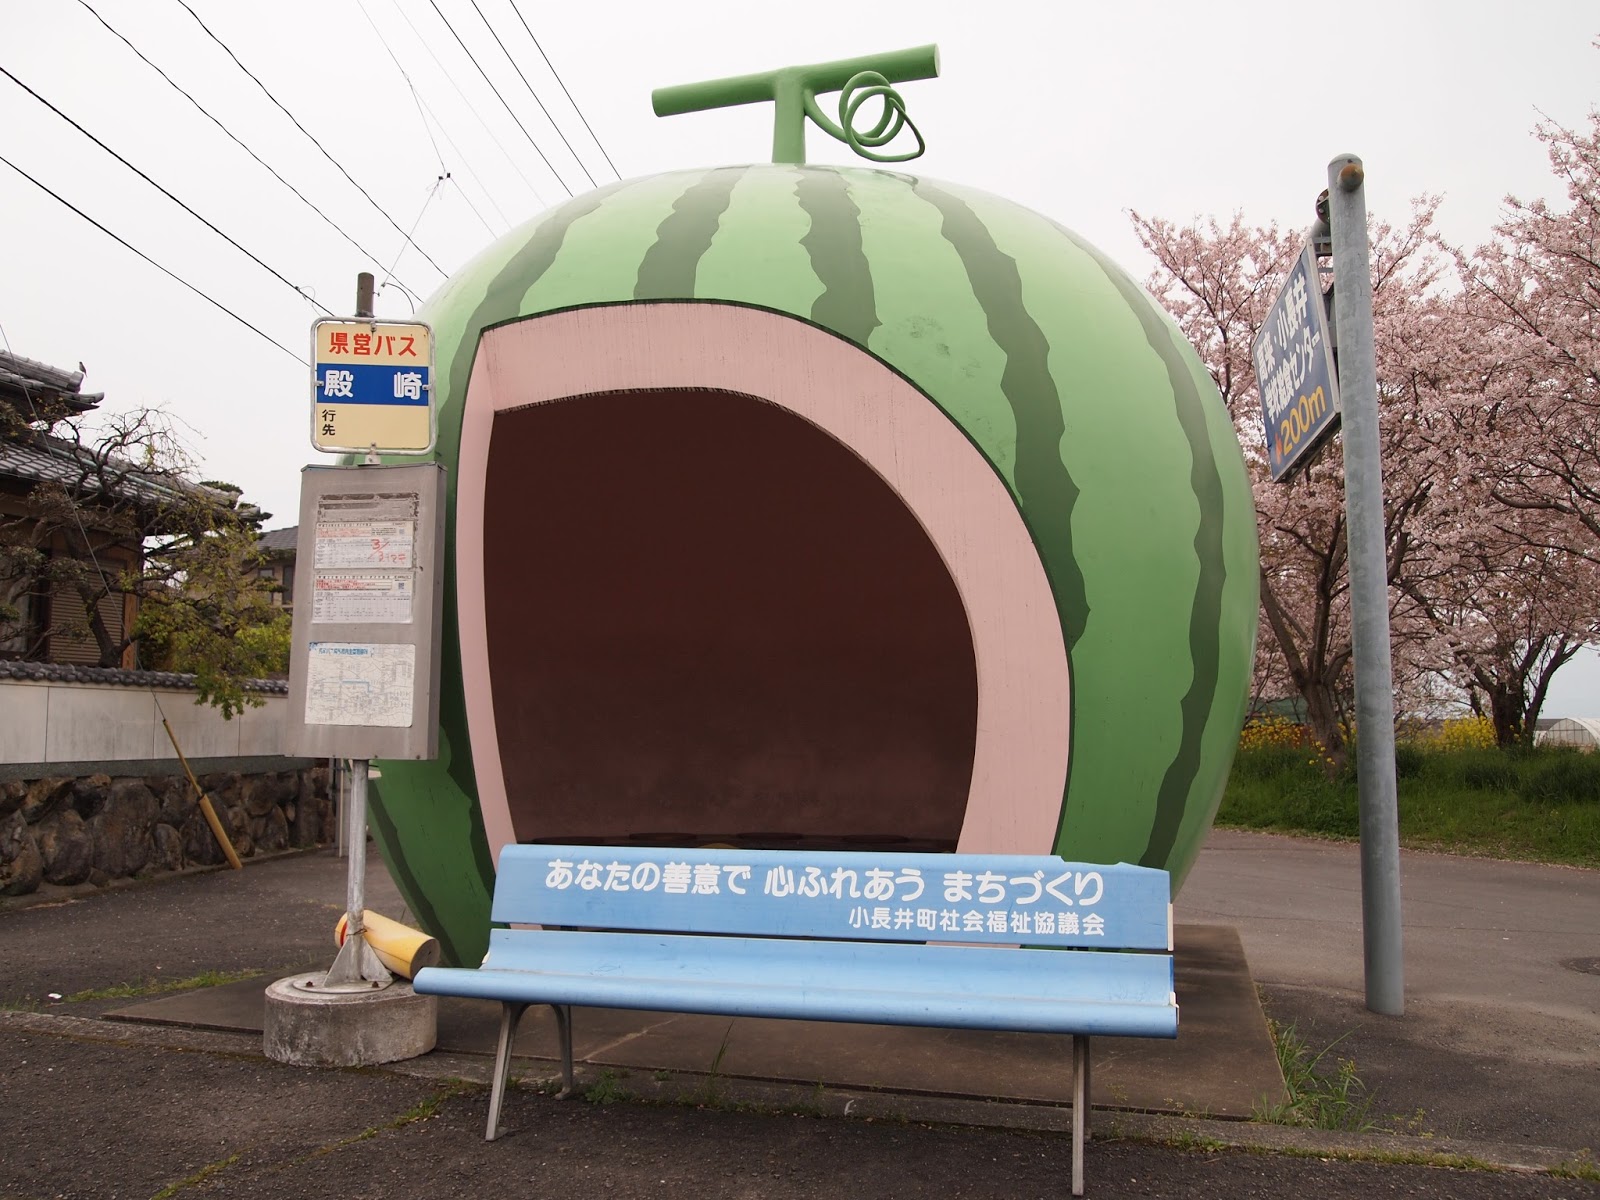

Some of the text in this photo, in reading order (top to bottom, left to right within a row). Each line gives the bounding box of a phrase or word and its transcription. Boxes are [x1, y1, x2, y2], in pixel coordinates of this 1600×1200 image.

[328, 331, 417, 357] 県営バス
[1264, 325, 1321, 425] 学校給食センター
[321, 408, 336, 436] 行先
[1280, 385, 1327, 457] 200m
[545, 858, 1104, 906] あなたの善意で 心ふれあう まちづくり
[848, 906, 1105, 937] 小長井町社会福祉協議会
